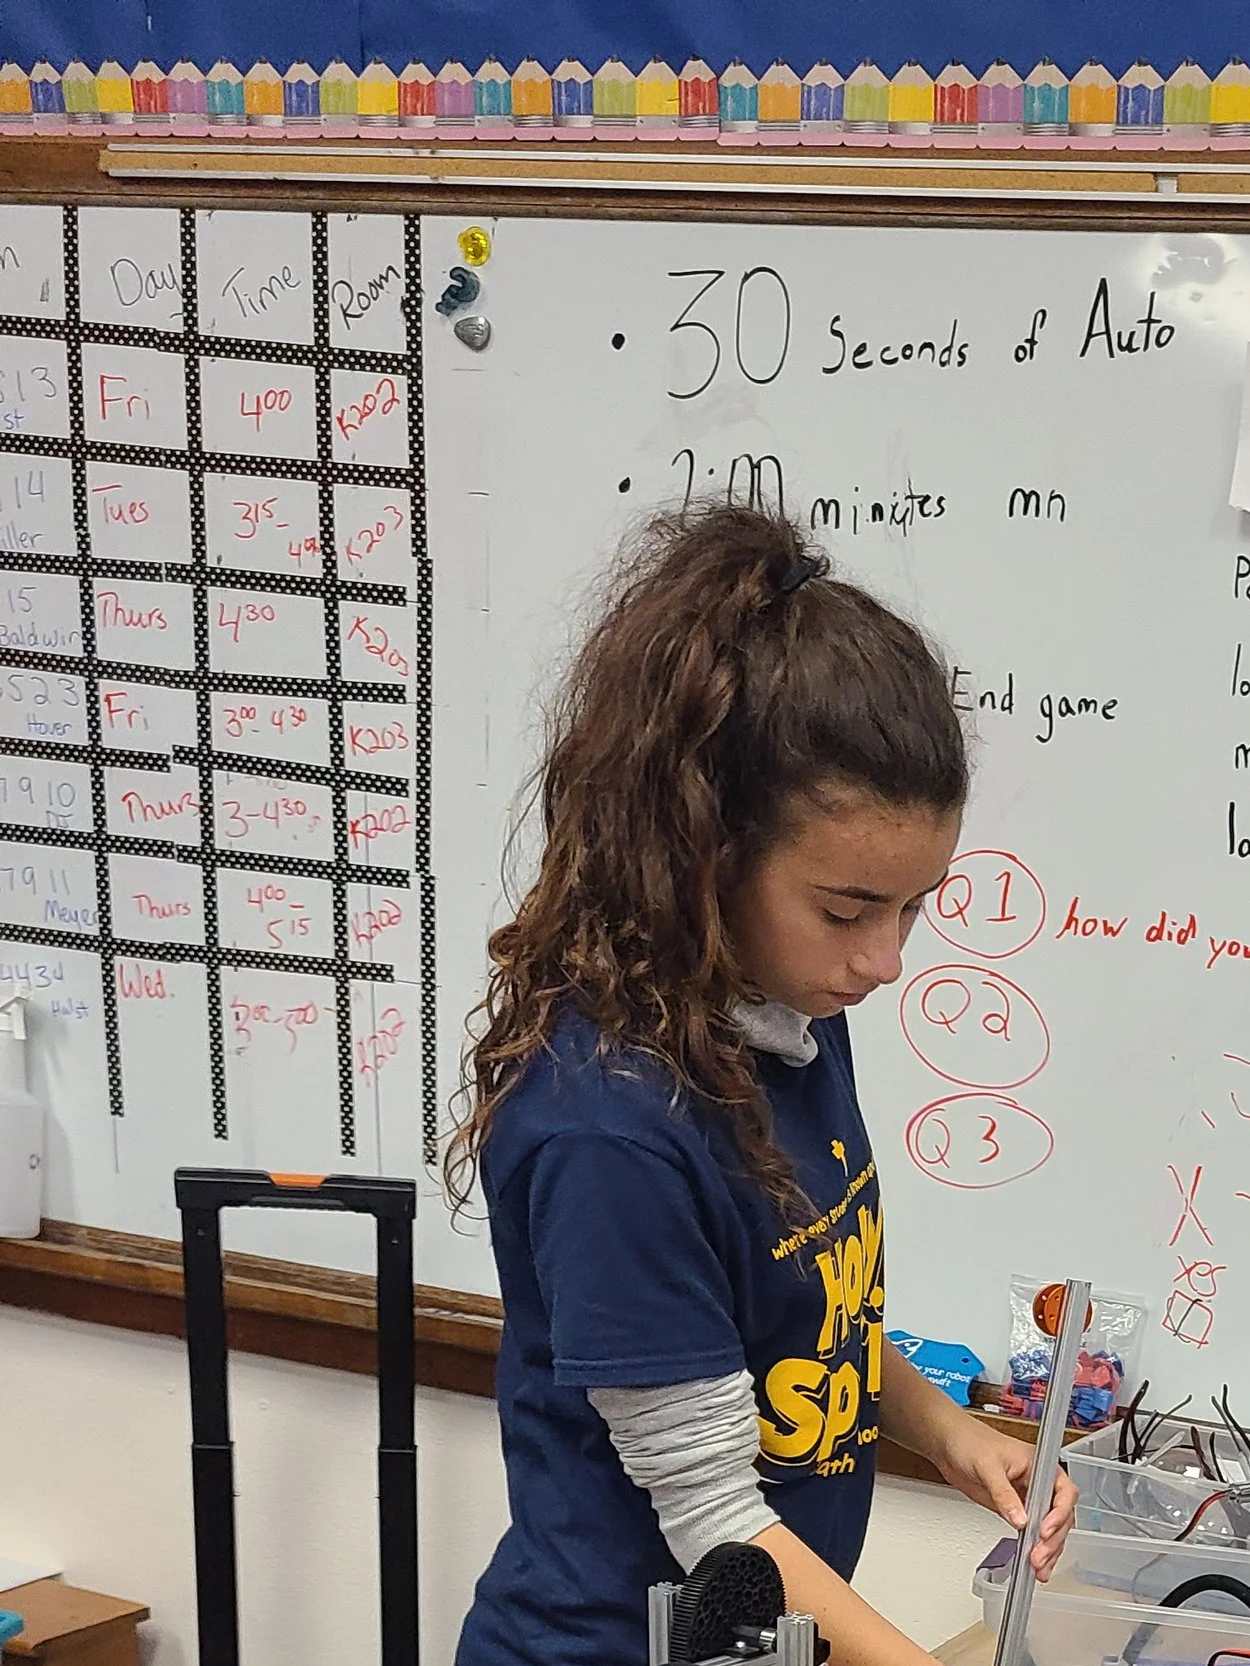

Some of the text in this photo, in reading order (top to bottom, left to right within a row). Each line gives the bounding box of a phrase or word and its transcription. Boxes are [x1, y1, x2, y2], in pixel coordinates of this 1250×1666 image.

[110, 257, 184, 319] Day
[222, 265, 302, 318] Time
[331, 265, 402, 331] Room
[667, 266, 1176, 400] 30 Seconds of Auto
[99, 373, 151, 422] Fri
[91, 483, 151, 527] Tues
[96, 591, 169, 631] Thurs
[0, 673, 81, 708] 523
[104, 691, 150, 732] Fri
[951, 665, 1120, 742] End game
[348, 721, 410, 758] K203
[120, 790, 202, 824] Thurs
[132, 893, 192, 918] Thurs
[1056, 896, 1126, 942] how
[1144, 910, 1198, 945] did
